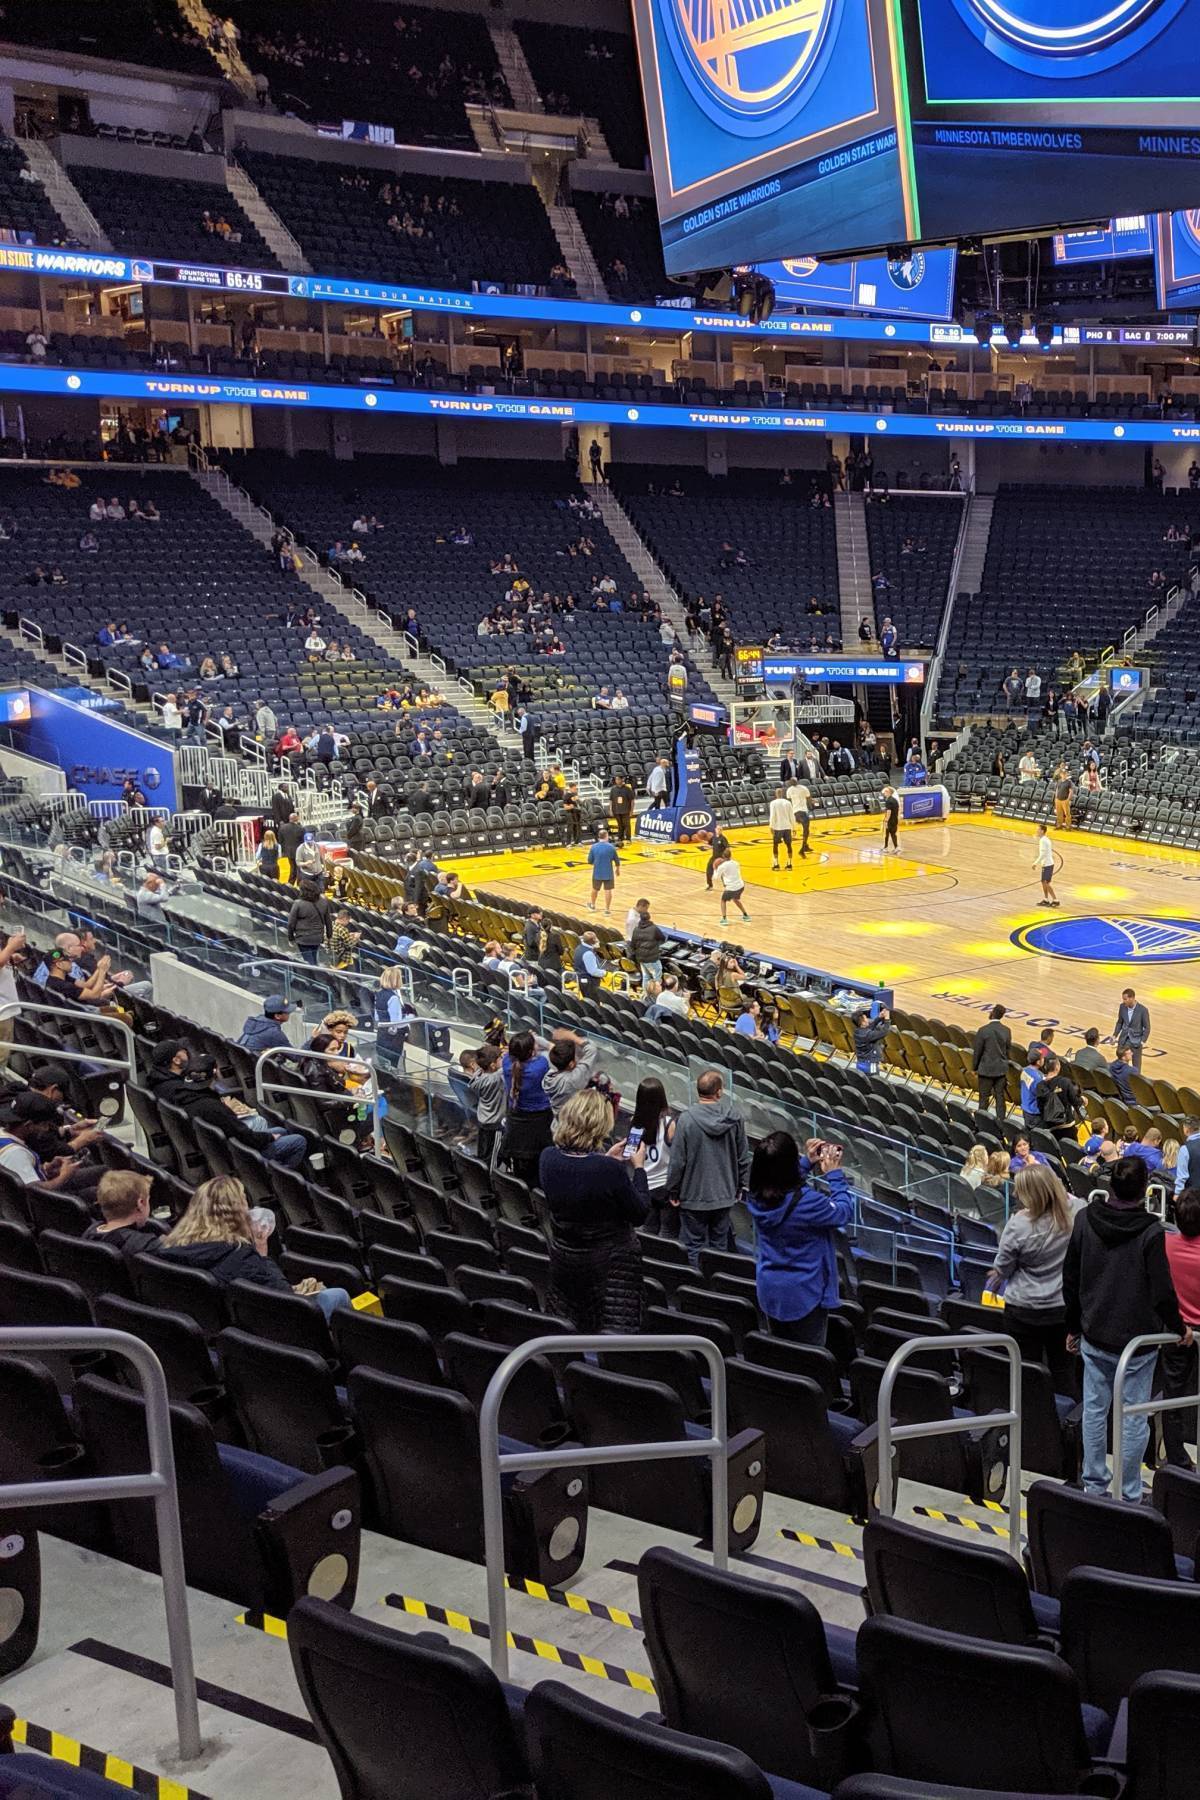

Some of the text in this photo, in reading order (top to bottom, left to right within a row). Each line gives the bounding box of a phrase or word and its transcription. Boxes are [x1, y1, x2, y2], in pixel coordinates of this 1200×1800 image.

[935, 130, 1082, 149] MINNESOTA TIMBERWOLVES
[818, 152, 850, 174] GOLDEN
[851, 141, 875, 162] STATE
[683, 179, 781, 233] GOLDEN STATE WARRIORS
[8, 251, 34, 268] STATE
[36, 253, 126, 277] WARRIORS
[179, 269, 219, 278] COUNTDOWN
[226, 273, 262, 290] 66:45
[314, 284, 471, 307] WE ARE DUB NATION
[694, 317, 734, 327] TURN
[759, 320, 787, 330] THE
[791, 322, 832, 332] GAME
[1086, 331, 1103, 340] PHO
[1125, 331, 1142, 340] SAC
[1156, 332, 1174, 340] 7:00
[1176, 332, 1188, 340] PM
[146, 382, 308, 400] TURN UP THE GAME
[430, 400, 573, 415] TURN UP THE GAME
[690, 413, 824, 427] TURN UP THE GAME
[936, 423, 1064, 434] TURN UP THE GAME
[808, 667, 825, 676] UP
[827, 667, 854, 676] THE
[858, 667, 898, 676] GAME
[71, 765, 139, 788] CHASE
[640, 814, 673, 833] thrive
[686, 814, 707, 826] KIA
